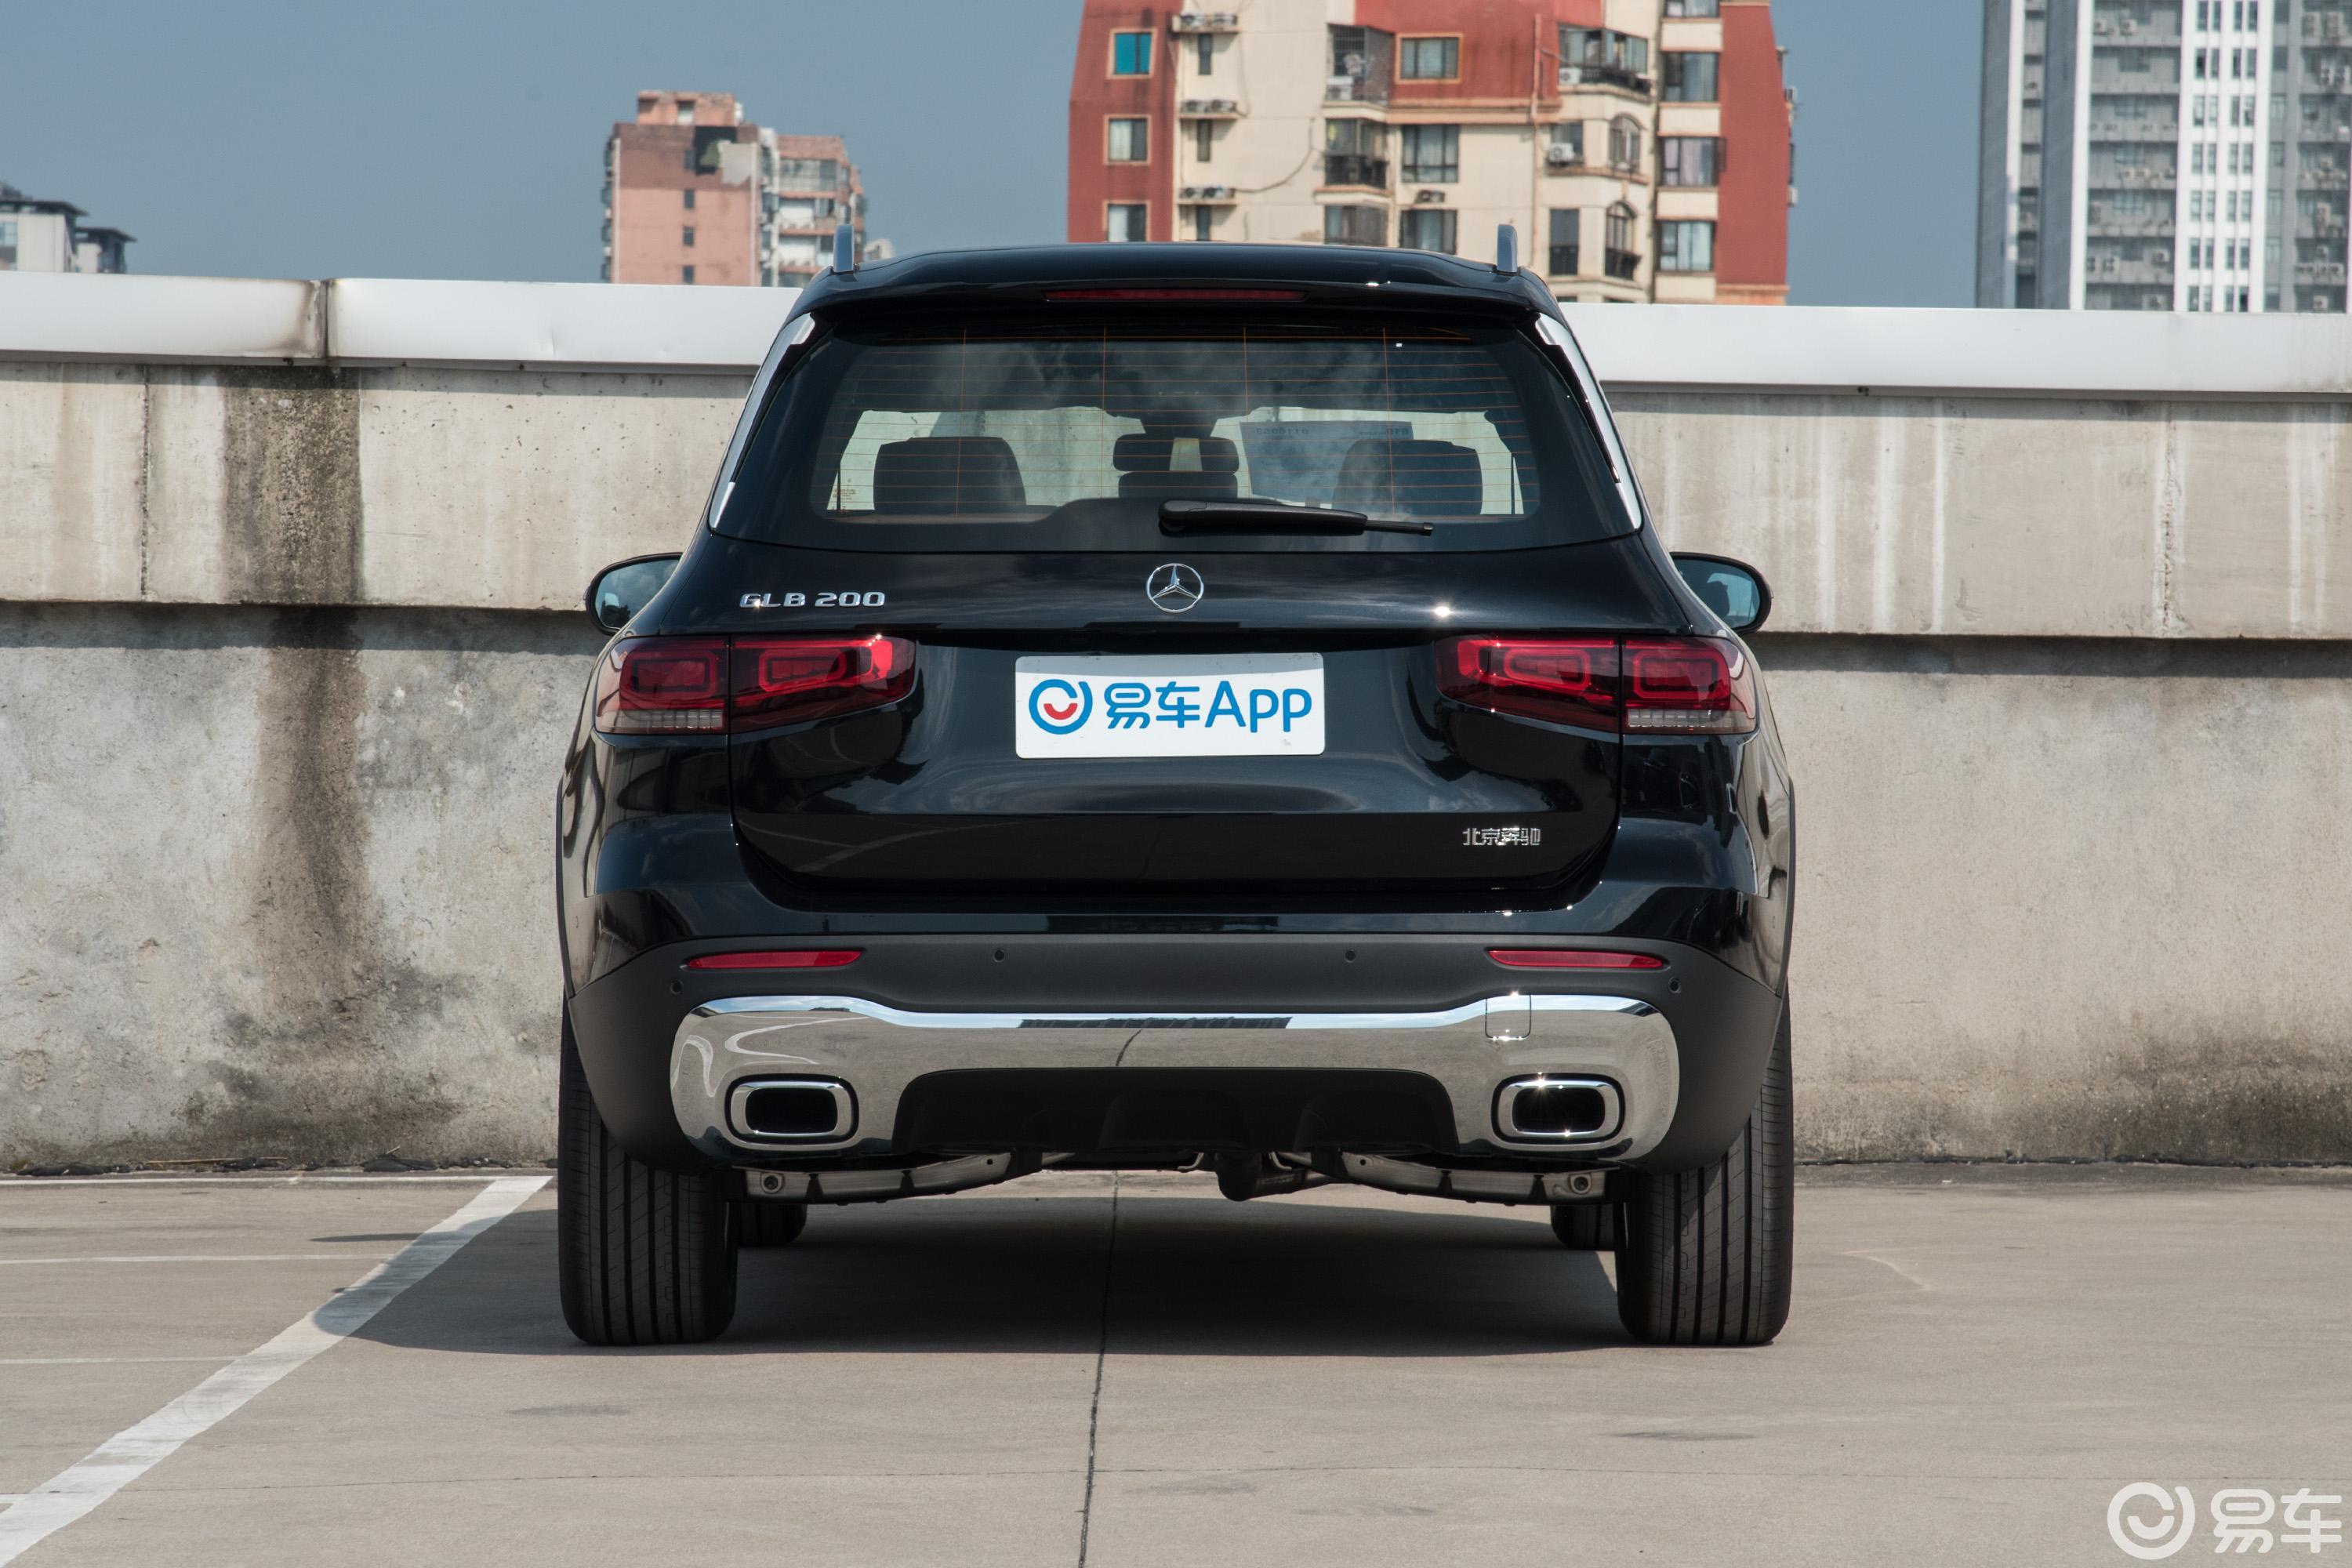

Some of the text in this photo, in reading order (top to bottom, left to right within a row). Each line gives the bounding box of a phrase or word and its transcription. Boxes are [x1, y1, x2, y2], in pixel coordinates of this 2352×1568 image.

[739, 591, 885, 608] GLB 200
[1103, 680, 1312, 734] 易车App
[1462, 827, 1541, 845] 北京奔驰
